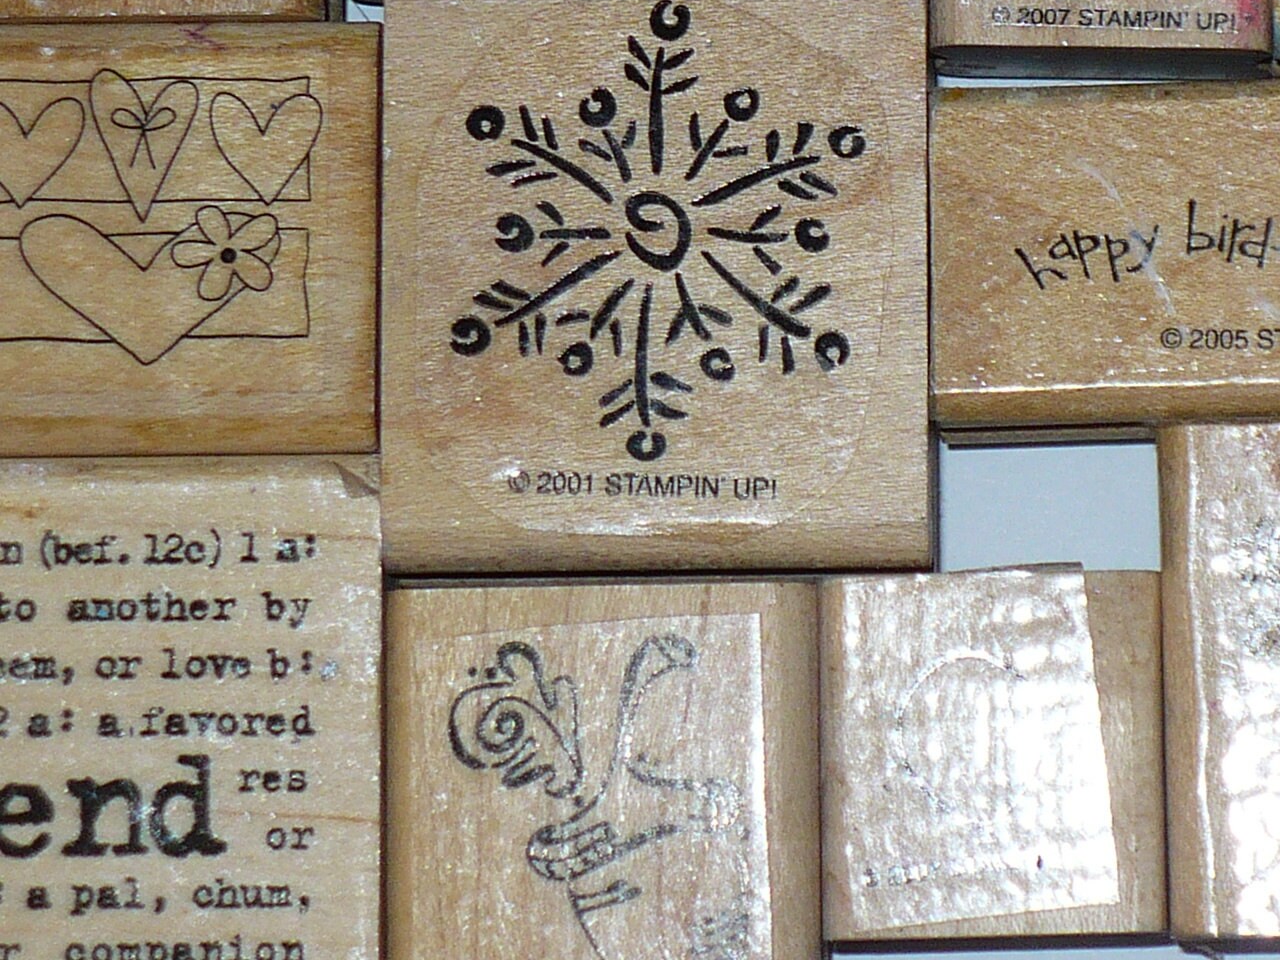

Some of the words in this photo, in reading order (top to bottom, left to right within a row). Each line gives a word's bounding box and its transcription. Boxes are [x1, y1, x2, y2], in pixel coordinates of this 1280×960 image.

[1016, 7, 1071, 26] 2007
[1078, 8, 1189, 29] STAMPIN'
[1015, 224, 1160, 290] happy
[1189, 329, 1248, 350] 2005
[536, 472, 593, 495] 2001
[605, 472, 726, 498] STAMPIN'
[734, 476, 777, 500] UP!
[40, 529, 130, 570] (bef.
[67, 591, 237, 622] another
[261, 591, 312, 629] by
[95, 655, 143, 680] or
[159, 647, 251, 680] love
[139, 705, 316, 739] favored
[237, 769, 309, 793] res
[265, 826, 315, 851] or
[26, 885, 52, 910] a
[69, 877, 166, 916] pal,
[192, 877, 311, 915] chum,
